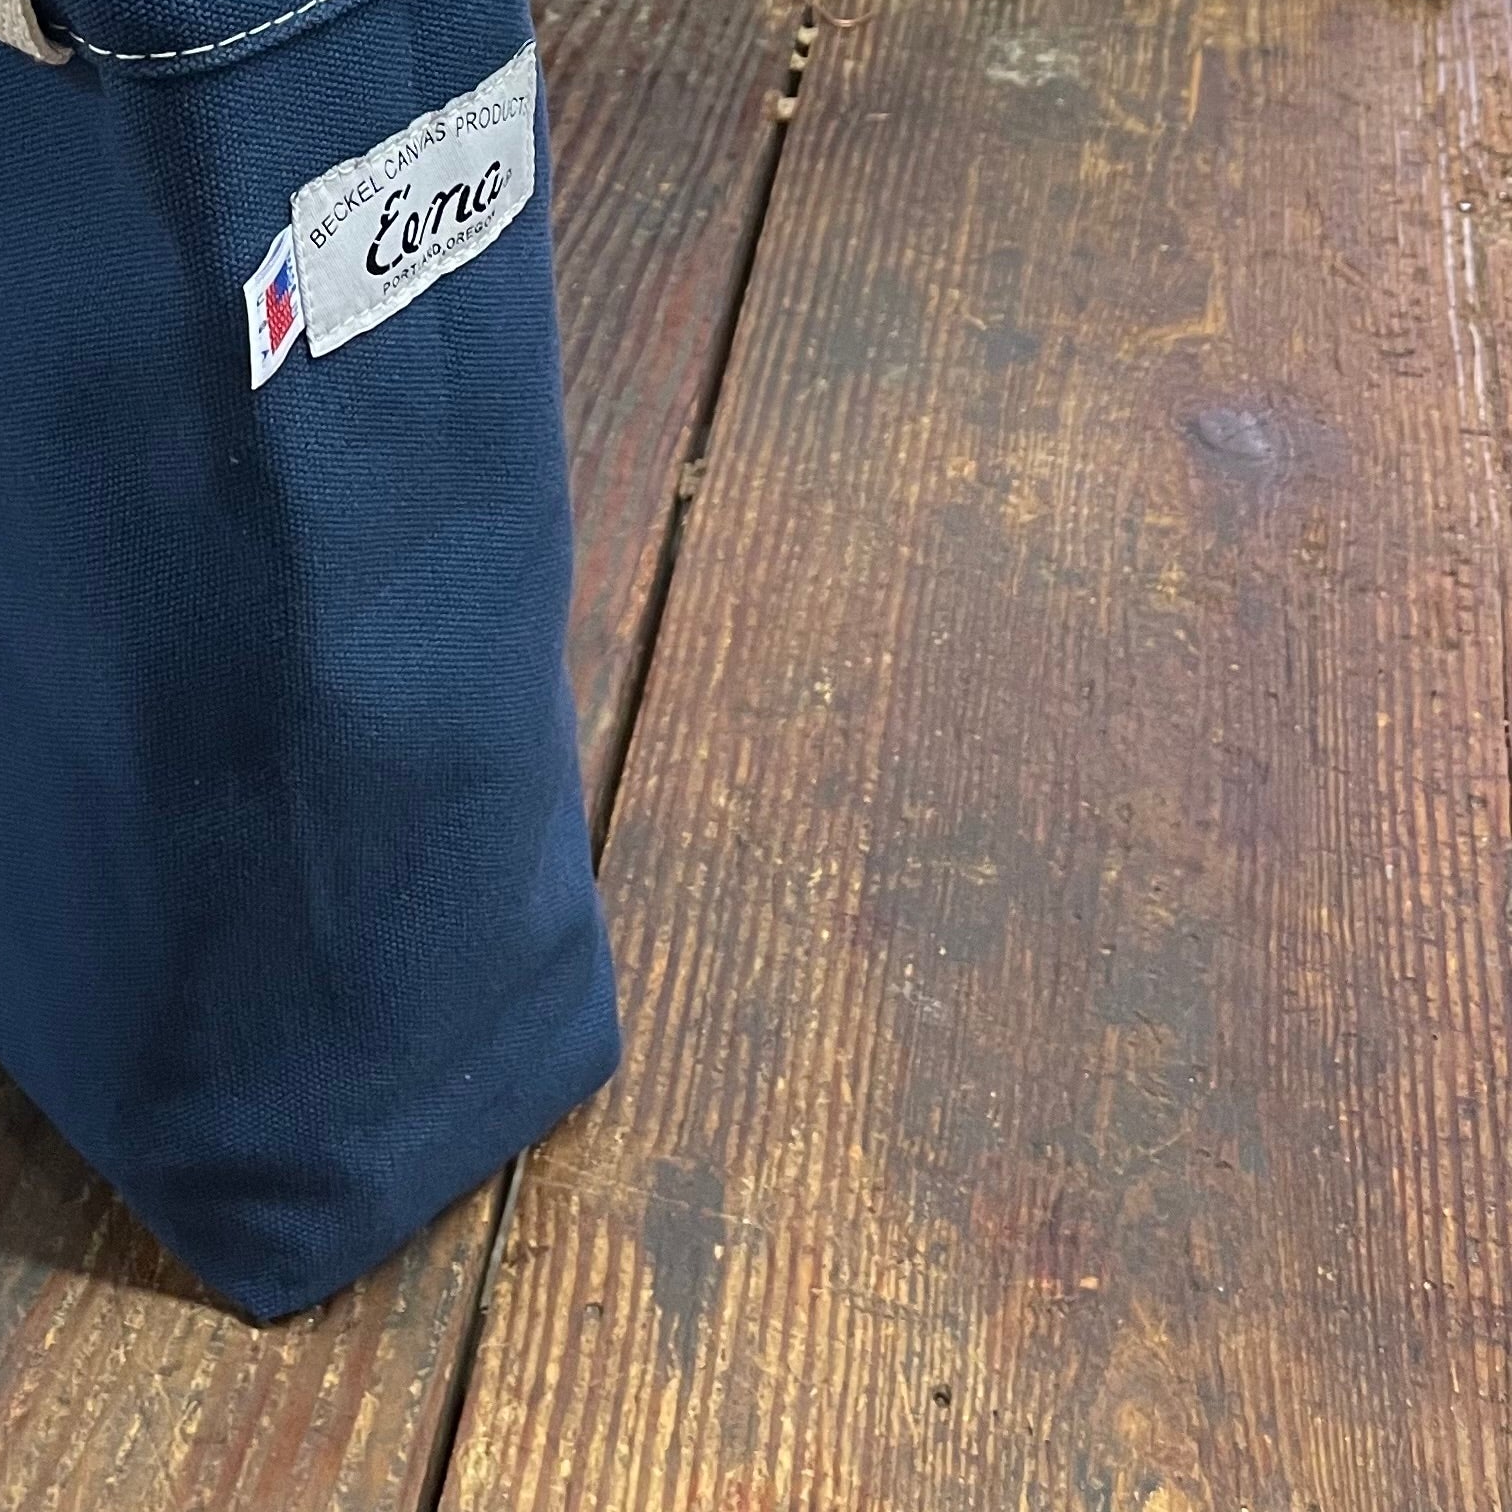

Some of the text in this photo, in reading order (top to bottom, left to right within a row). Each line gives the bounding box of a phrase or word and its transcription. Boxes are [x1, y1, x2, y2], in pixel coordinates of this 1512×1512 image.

[309, 174, 384, 249] BECKEL
[384, 122, 447, 180] CANVAS
[365, 160, 504, 276] Eena
